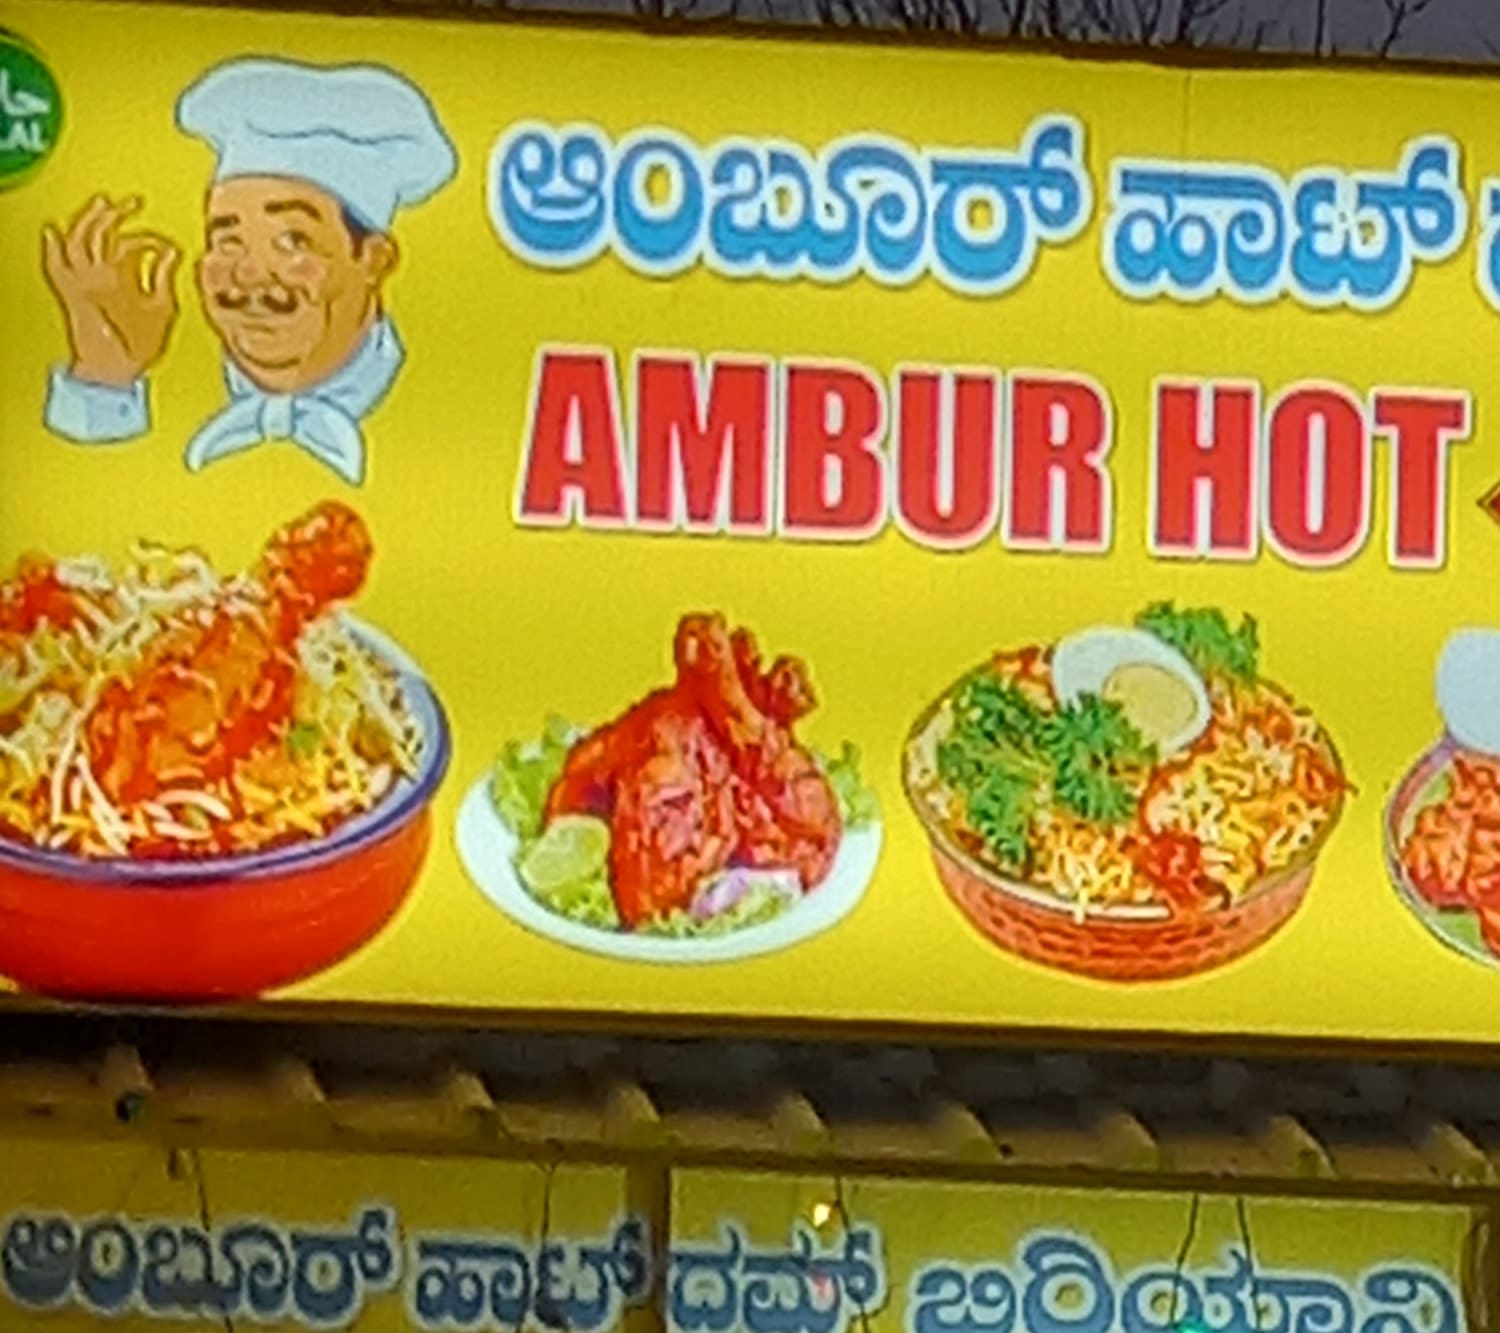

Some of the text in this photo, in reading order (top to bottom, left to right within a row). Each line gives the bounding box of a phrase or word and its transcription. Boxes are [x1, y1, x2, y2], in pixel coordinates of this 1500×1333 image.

[497, 120, 1084, 286] ಆಂಬೂರ್
[1112, 142, 1458, 297] ಹಾಟ್
[519, 351, 1108, 544] AMBUR
[1152, 382, 1467, 562] HOT
[2, 1208, 395, 1324] ಆಂಬೂರ್
[415, 1214, 649, 1331] ಹಾಟ್
